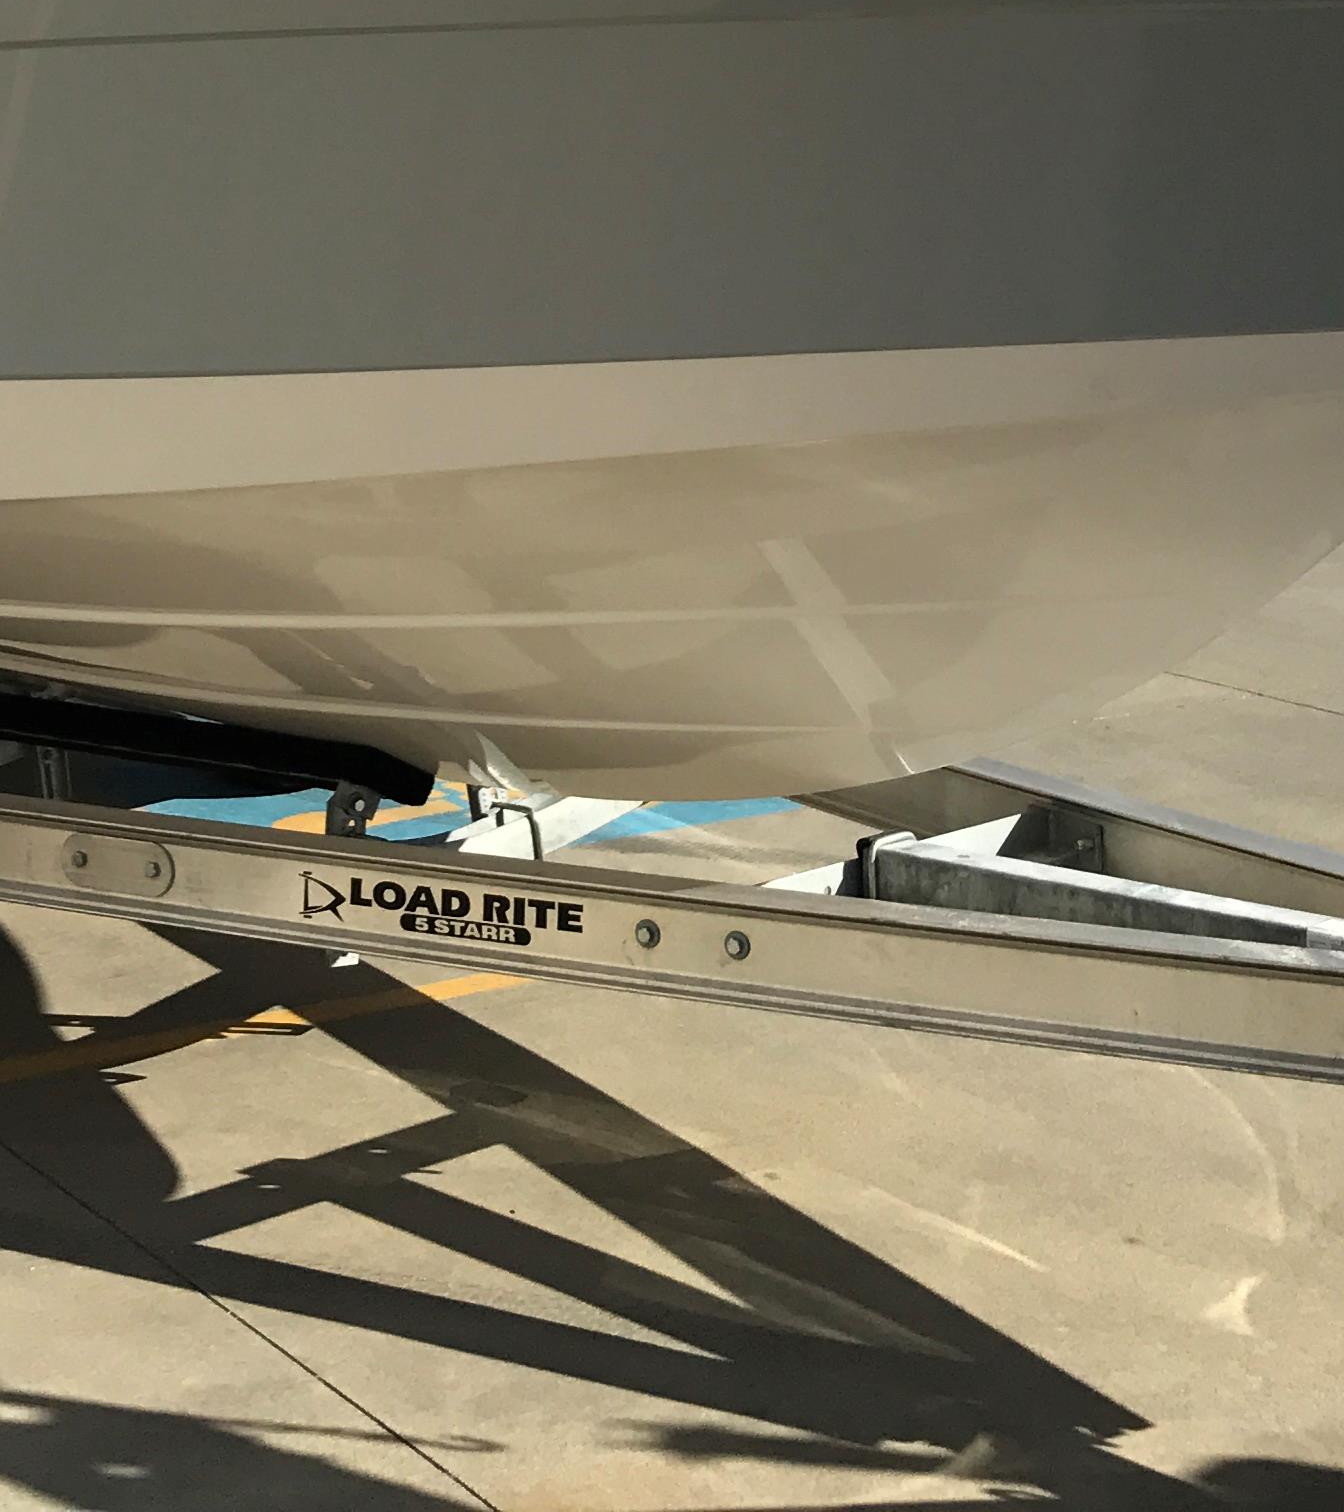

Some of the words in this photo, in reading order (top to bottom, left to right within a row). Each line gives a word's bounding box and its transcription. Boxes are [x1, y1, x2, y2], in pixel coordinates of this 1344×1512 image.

[349, 876, 471, 918] LOAD
[482, 893, 584, 934] RITE
[414, 917, 429, 932] 5
[433, 919, 517, 944] STARR
